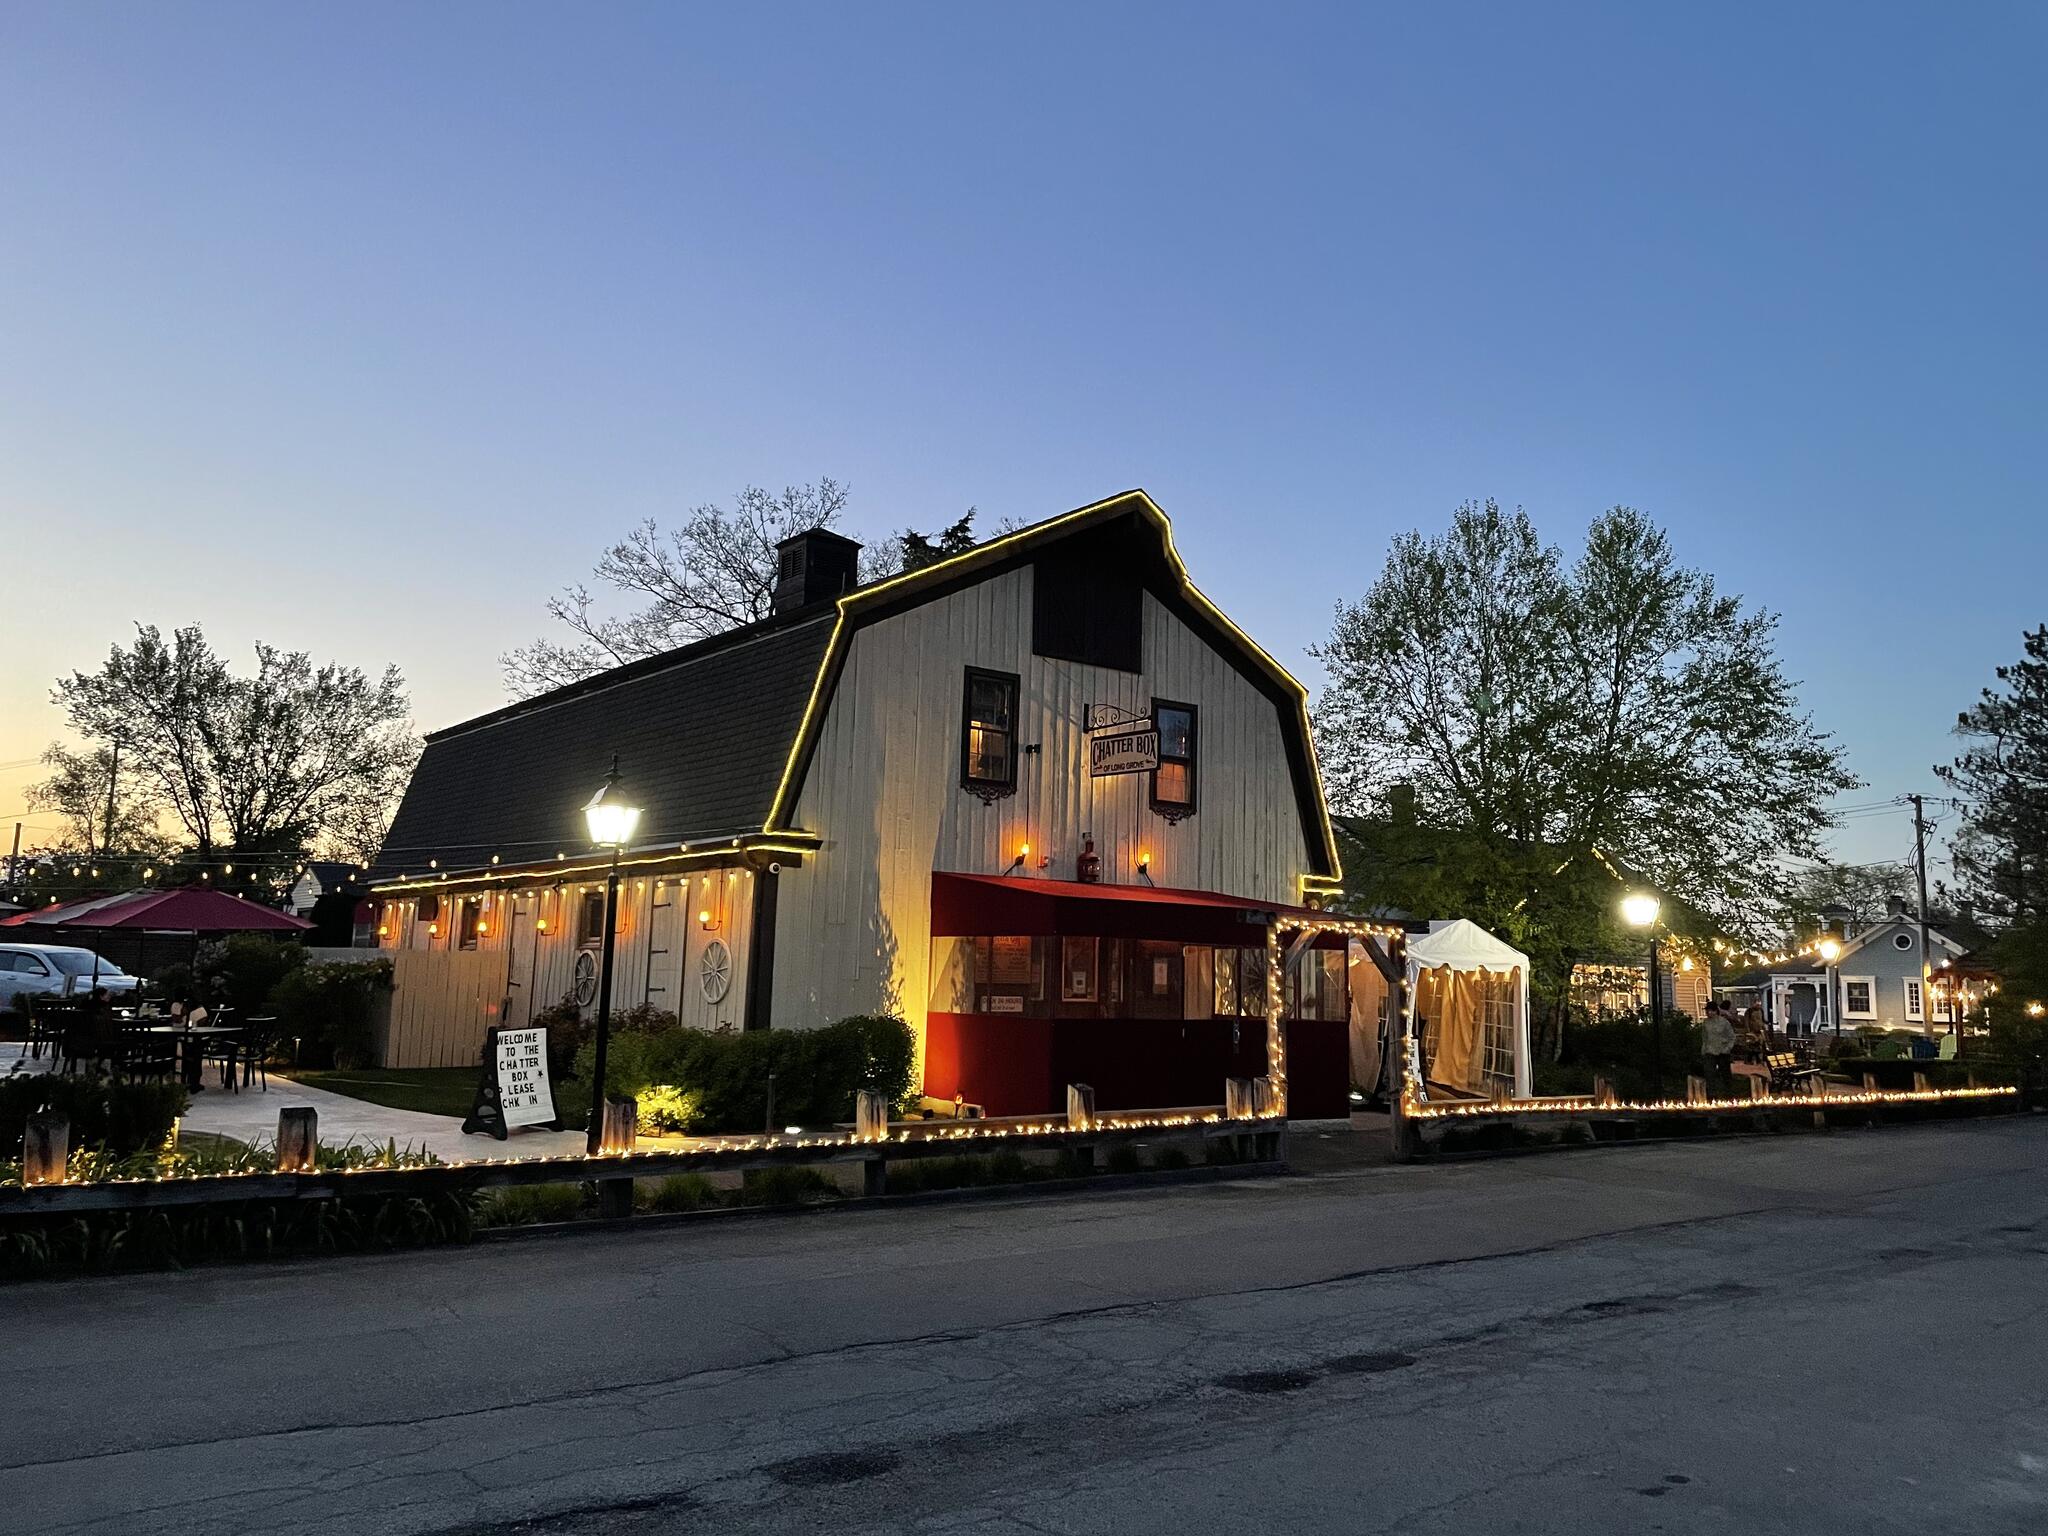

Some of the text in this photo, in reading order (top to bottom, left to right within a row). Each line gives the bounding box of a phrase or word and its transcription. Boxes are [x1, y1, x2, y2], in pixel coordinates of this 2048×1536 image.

[1093, 734, 1156, 766] CHATTER BOX
[1103, 764, 1111, 772] OF
[498, 1033, 537, 1045] WELCOME
[506, 1045, 539, 1057] TO THE
[499, 1058, 539, 1071] CHATTER
[511, 1071, 528, 1082] BOX
[502, 1095, 538, 1108] CHK IN
